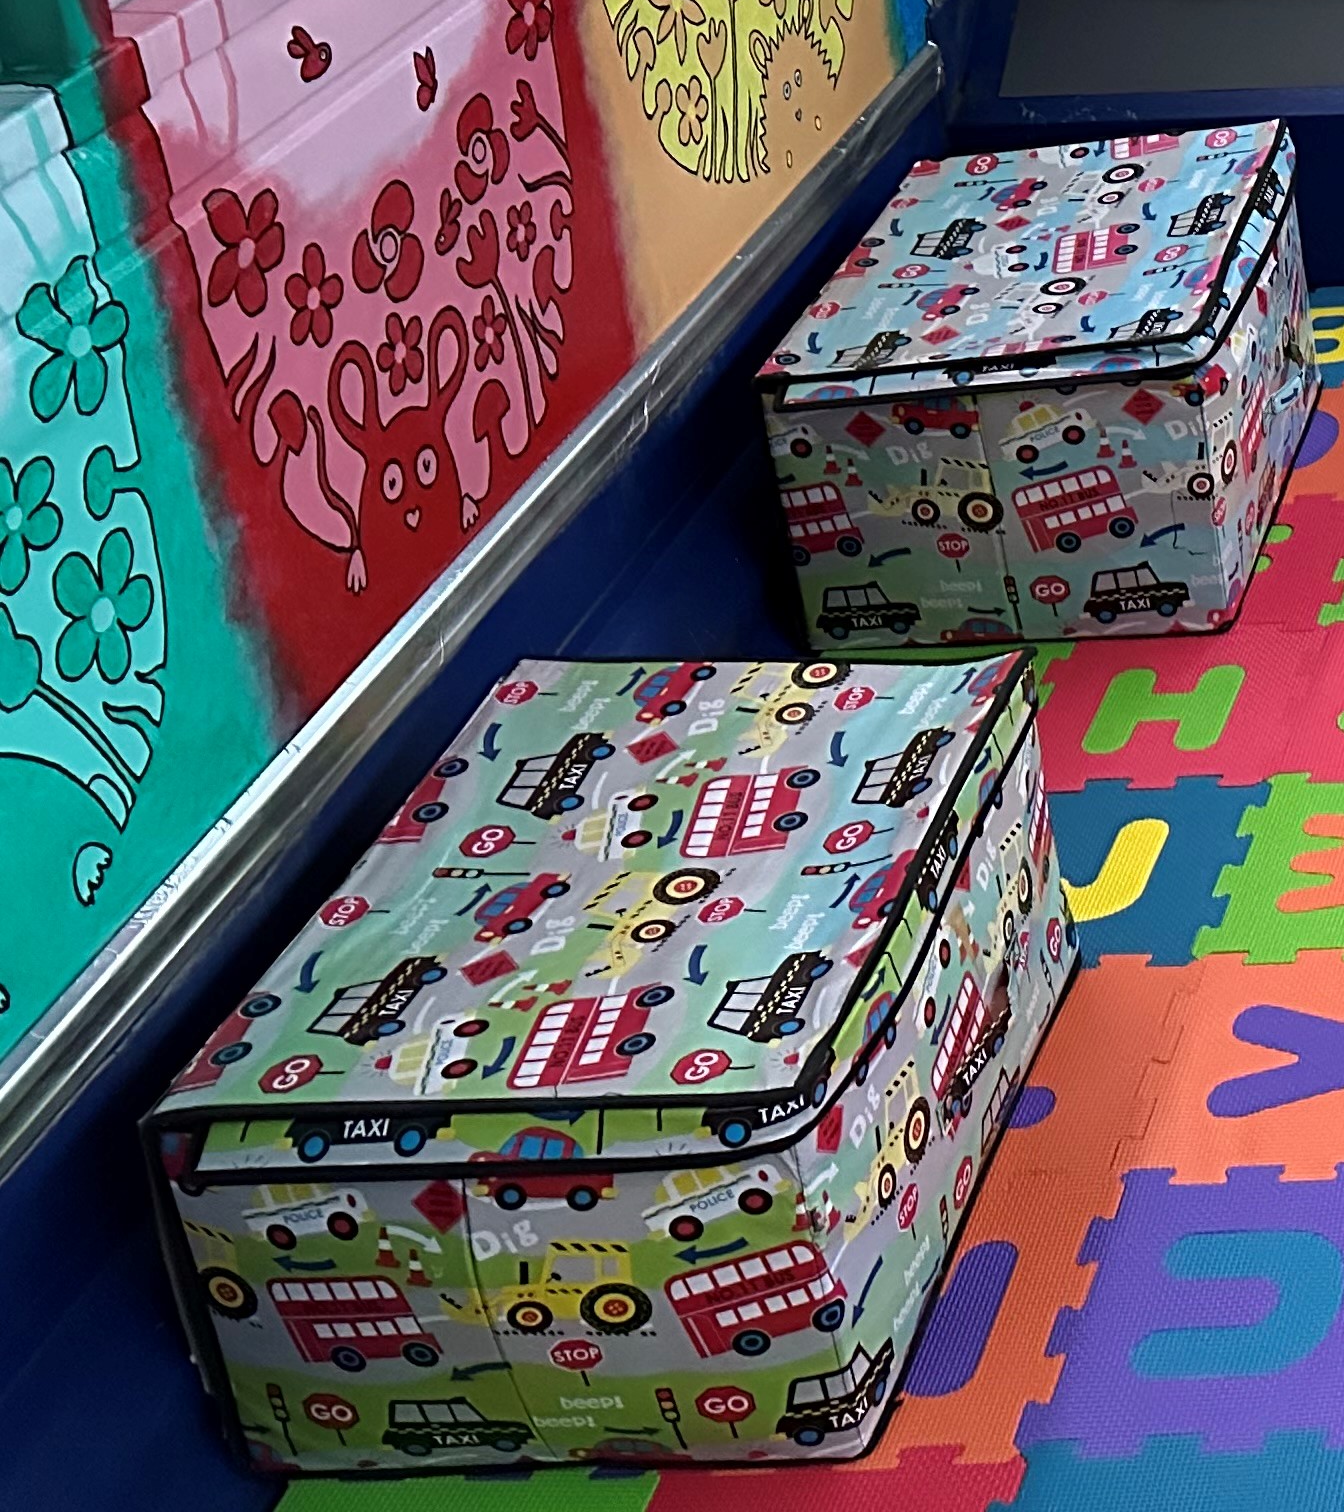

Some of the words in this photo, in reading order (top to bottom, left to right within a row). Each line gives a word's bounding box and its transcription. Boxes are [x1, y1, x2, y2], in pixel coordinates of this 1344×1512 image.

[886, 442, 933, 466] Dig
[938, 540, 969, 553] STOP
[1035, 583, 1066, 597] GO
[1120, 598, 1151, 611] TAXI
[851, 616, 883, 628] TAXI
[843, 686, 867, 710] STOP
[558, 763, 588, 790] TAXI
[472, 828, 504, 855] GO
[835, 824, 864, 850] GO
[930, 844, 949, 879] TAXI
[328, 896, 359, 926] STOP
[707, 896, 734, 923] STOP
[379, 989, 415, 1017] TAXI
[776, 986, 806, 1015] TAXI
[272, 1059, 311, 1090] GO
[684, 1052, 720, 1081] GO
[962, 1052, 988, 1087] TAXI
[758, 1094, 806, 1124] TAXI
[343, 1118, 390, 1139] TAXI
[954, 1161, 973, 1202] GO
[689, 1188, 736, 1212] POLICE
[898, 1196, 920, 1226] STOP
[283, 1207, 325, 1223] POLICE
[471, 1219, 539, 1262] Dig
[765, 1268, 797, 1286] BUS
[552, 1344, 600, 1365] STOP
[309, 1403, 353, 1422] GO
[560, 1394, 624, 1410] beep!
[703, 1395, 750, 1417] GO
[533, 1415, 596, 1430] beep!
[829, 1399, 869, 1432] TAXI
[431, 1434, 480, 1446] TAXI
